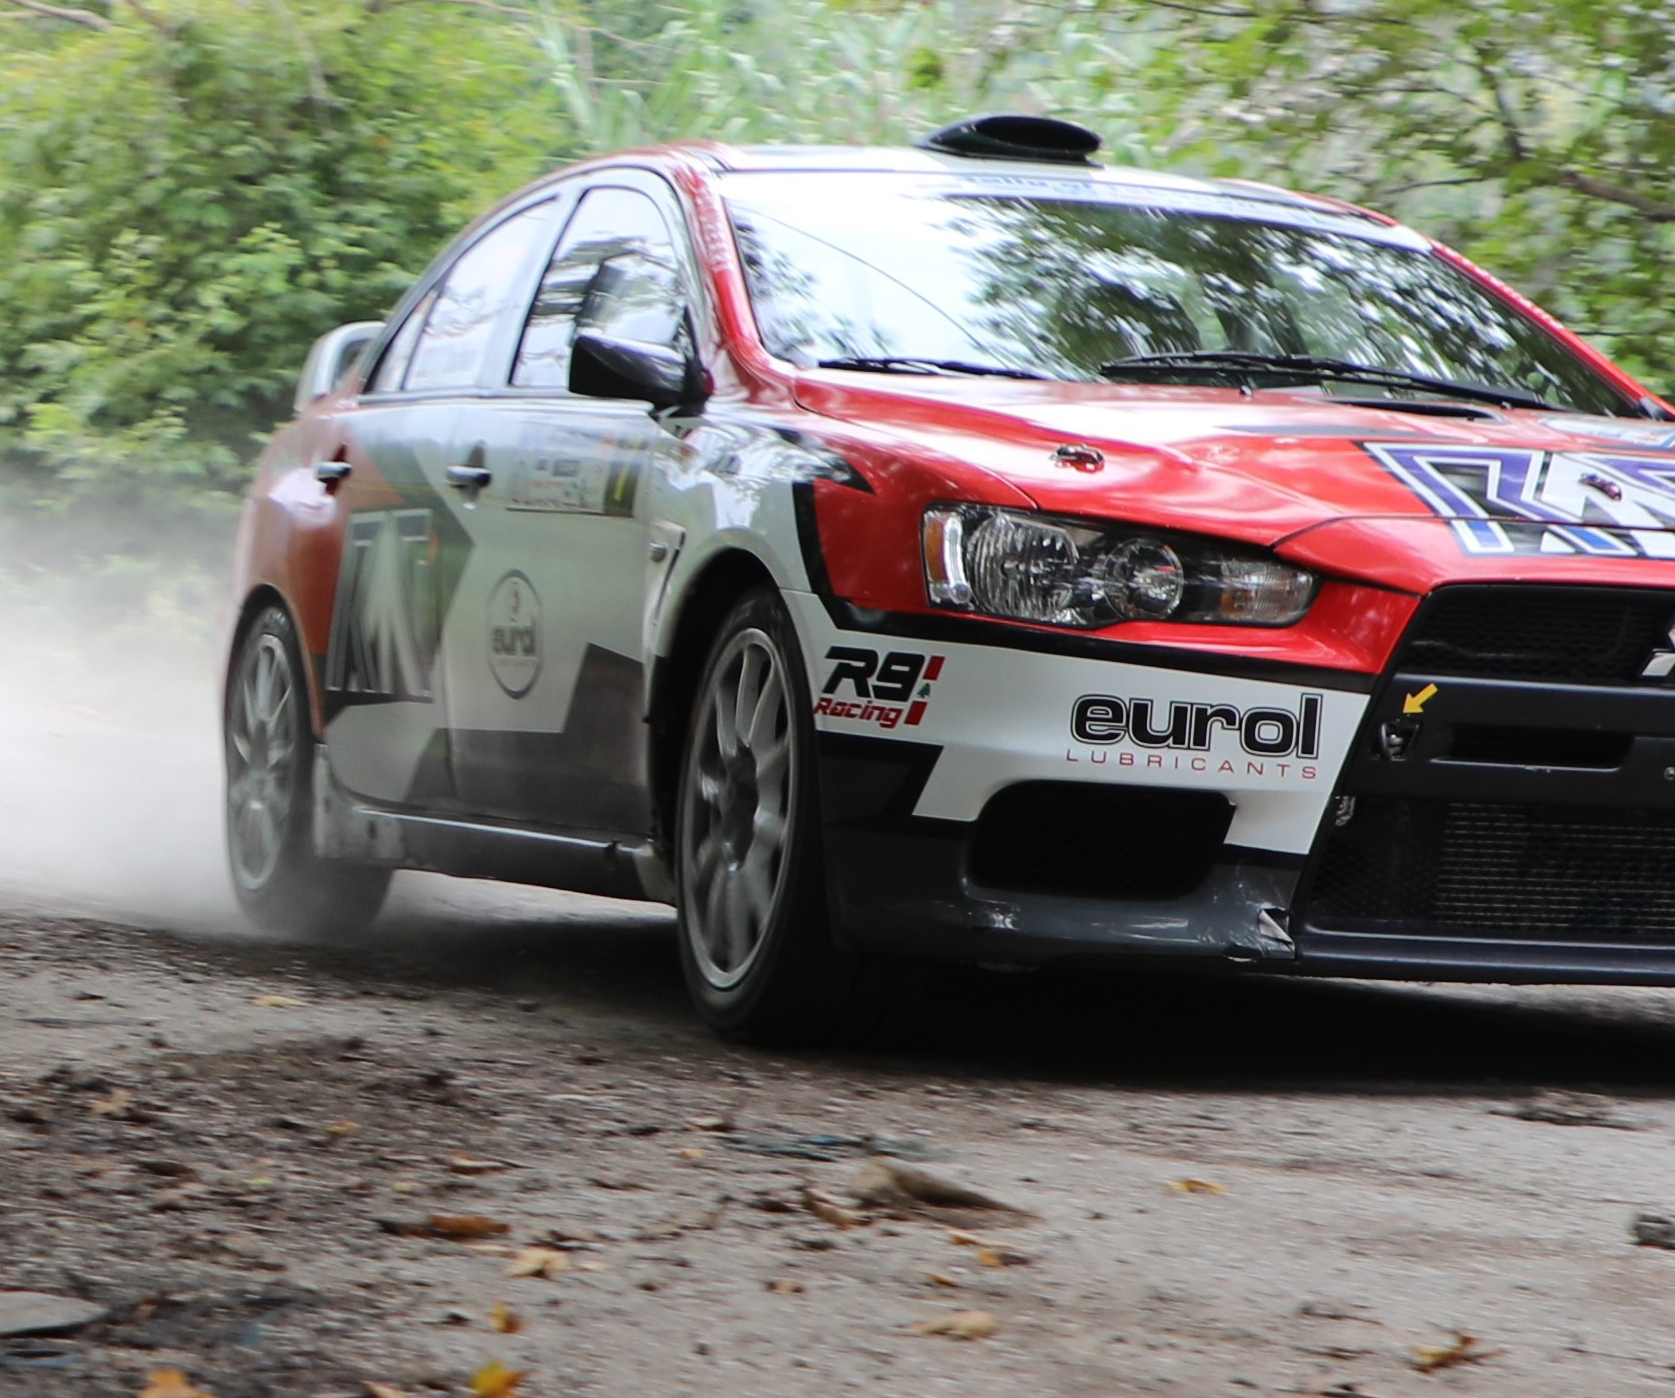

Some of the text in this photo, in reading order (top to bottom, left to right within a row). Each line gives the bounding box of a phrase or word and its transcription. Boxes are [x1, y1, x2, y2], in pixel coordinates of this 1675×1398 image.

[822, 645, 926, 702] R9
[813, 697, 904, 729] Racing
[1070, 693, 1324, 760] eurol
[1066, 749, 1318, 780] LUBRICANTS
